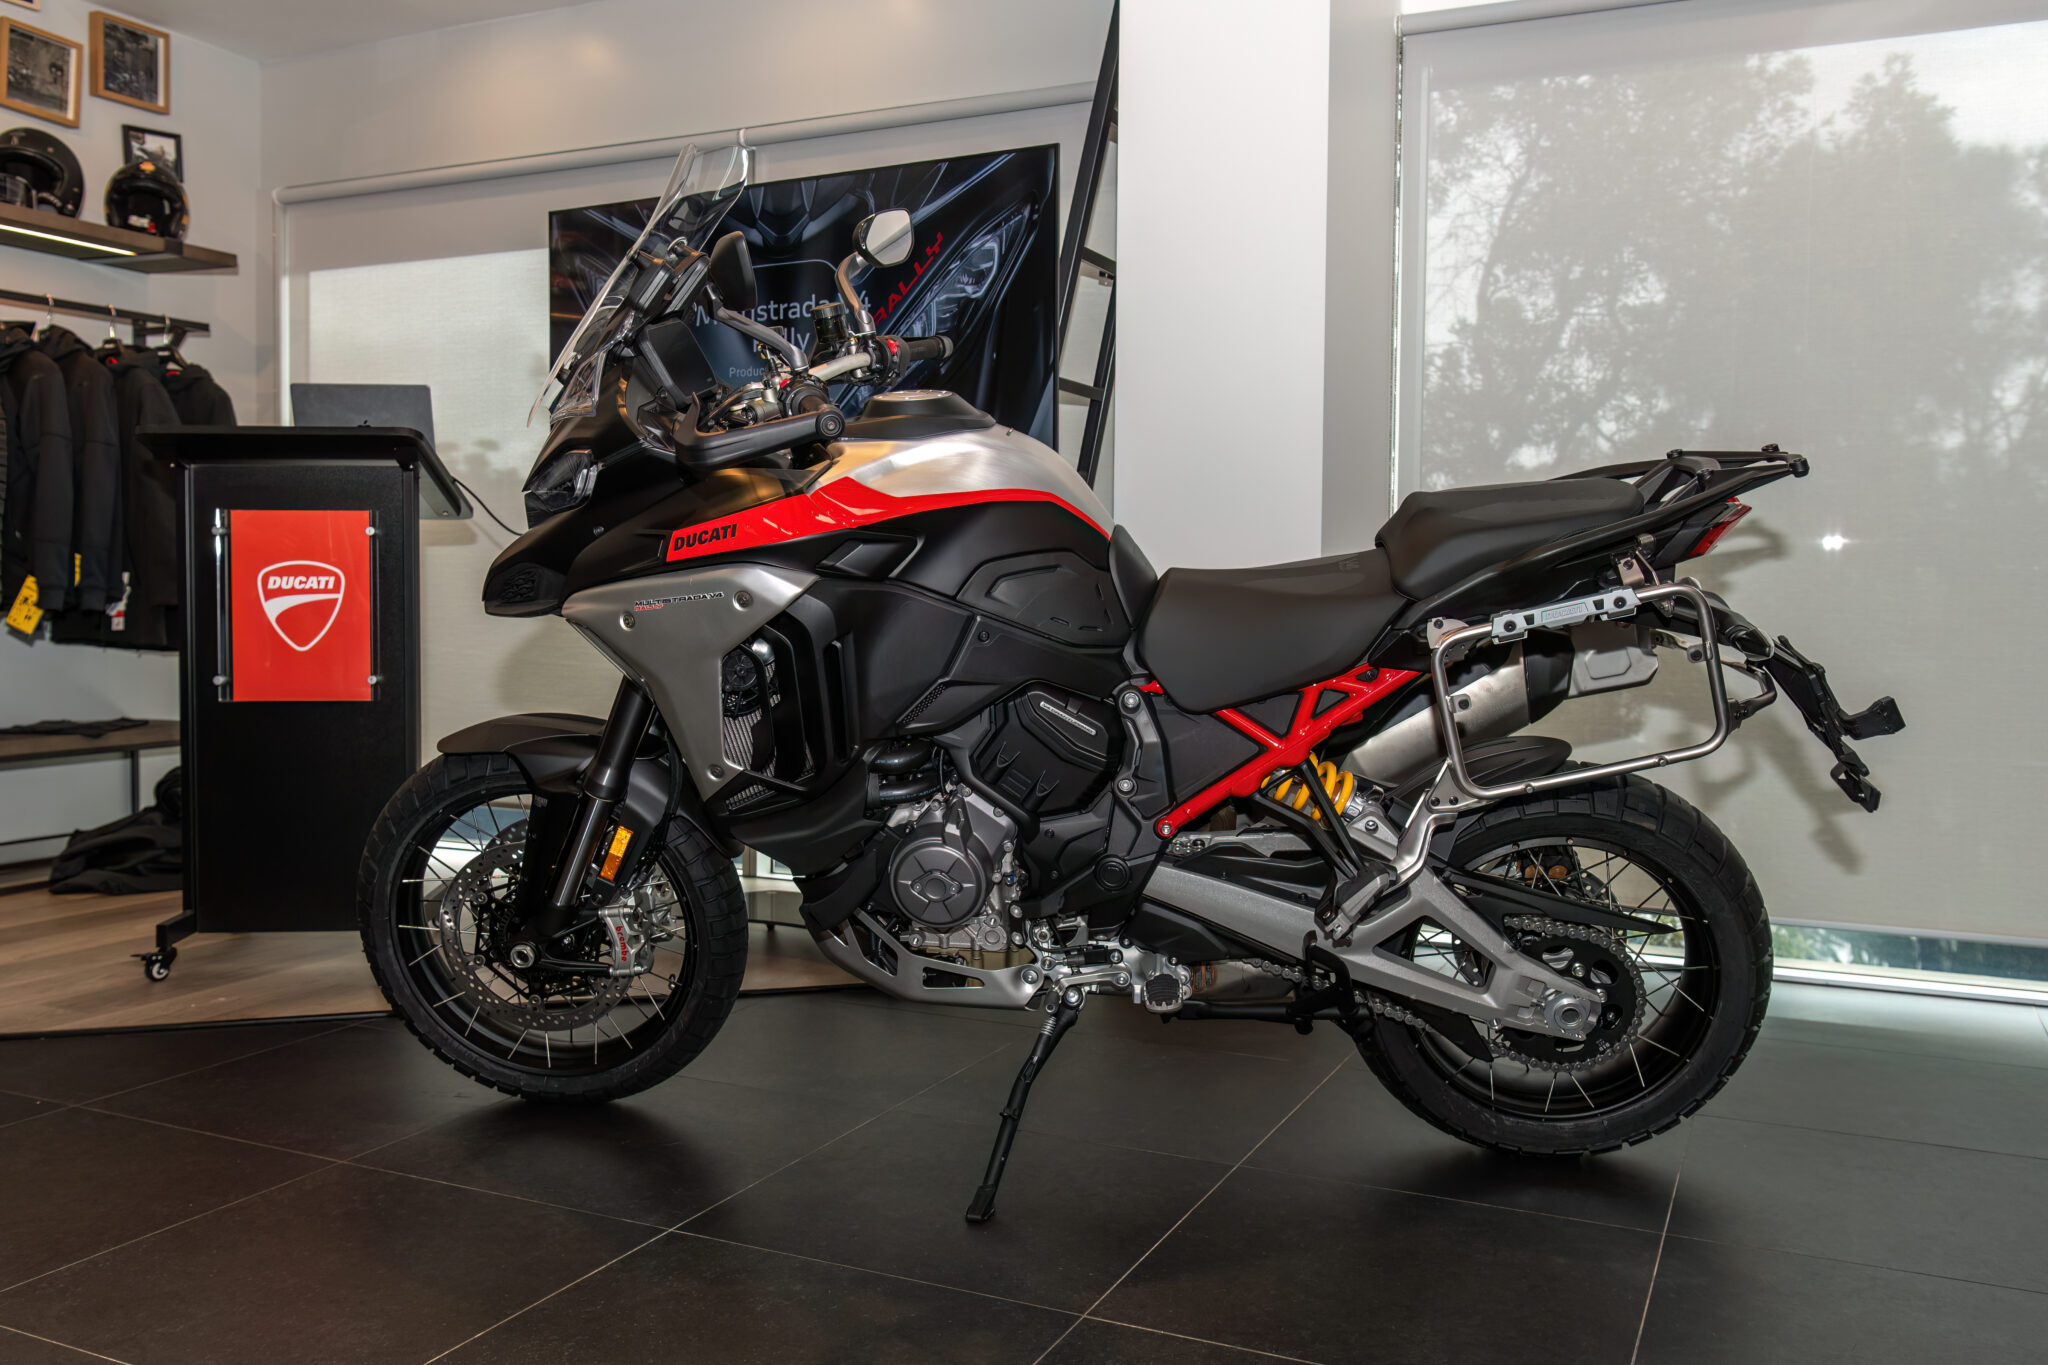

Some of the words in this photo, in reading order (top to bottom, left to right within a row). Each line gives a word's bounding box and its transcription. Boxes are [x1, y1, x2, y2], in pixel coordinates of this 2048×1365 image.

[674, 523, 738, 551] DUCATI
[267, 575, 336, 590] DUCATI
[634, 594, 707, 606] MULTISTRADA
[708, 592, 724, 600] V4
[616, 925, 629, 962] brembo
